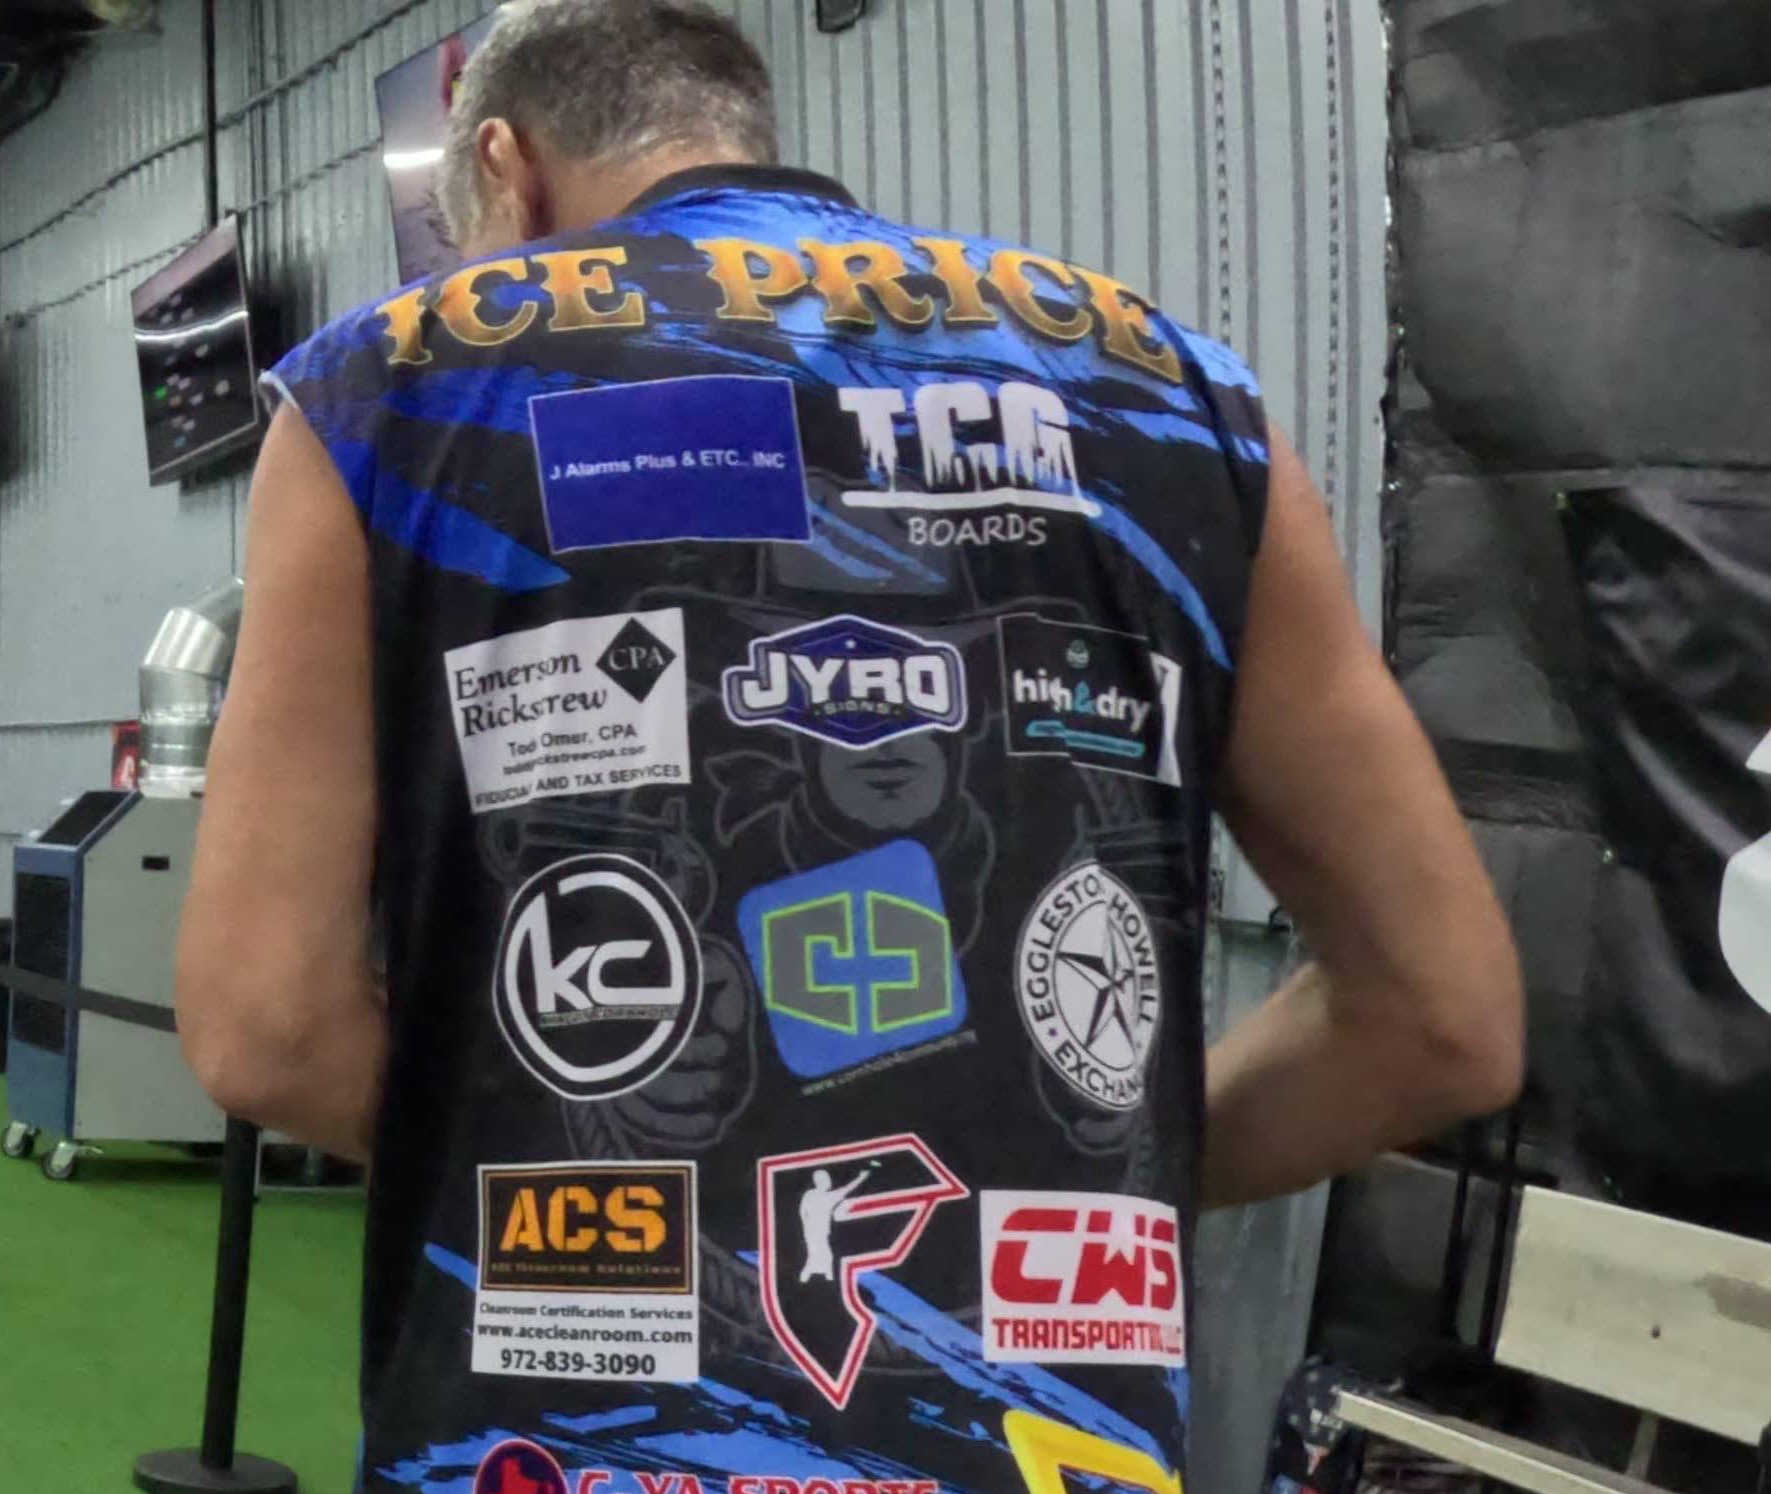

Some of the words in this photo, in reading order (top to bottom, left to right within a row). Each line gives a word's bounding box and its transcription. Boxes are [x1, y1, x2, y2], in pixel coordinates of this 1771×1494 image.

[695, 237, 1183, 385] PRICE
[550, 466, 561, 480] J
[565, 459, 632, 479] Alarms
[635, 453, 677, 471] Plus
[681, 450, 696, 467] &
[752, 451, 786, 468] INC
[907, 513, 1048, 547] BOARDS
[608, 645, 665, 672] CPA
[453, 652, 582, 703] Emerson
[740, 650, 952, 715] JYRO
[460, 687, 608, 739] Ricksrew
[507, 738, 537, 759] Tod
[598, 724, 638, 742] CPA
[536, 774, 570, 792] AND
[575, 771, 605, 788] TAX
[610, 764, 682, 785] SERVICES
[1025, 873, 1104, 1024] EGGLESTO
[500, 1185, 667, 1254] ACS
[991, 1207, 1178, 1311] CWS
[540, 1305, 625, 1320] Certification
[630, 1307, 693, 1321] Services
[477, 1323, 693, 1344] www.acecleanroom.com
[500, 1348, 657, 1376] 972-839-3090
